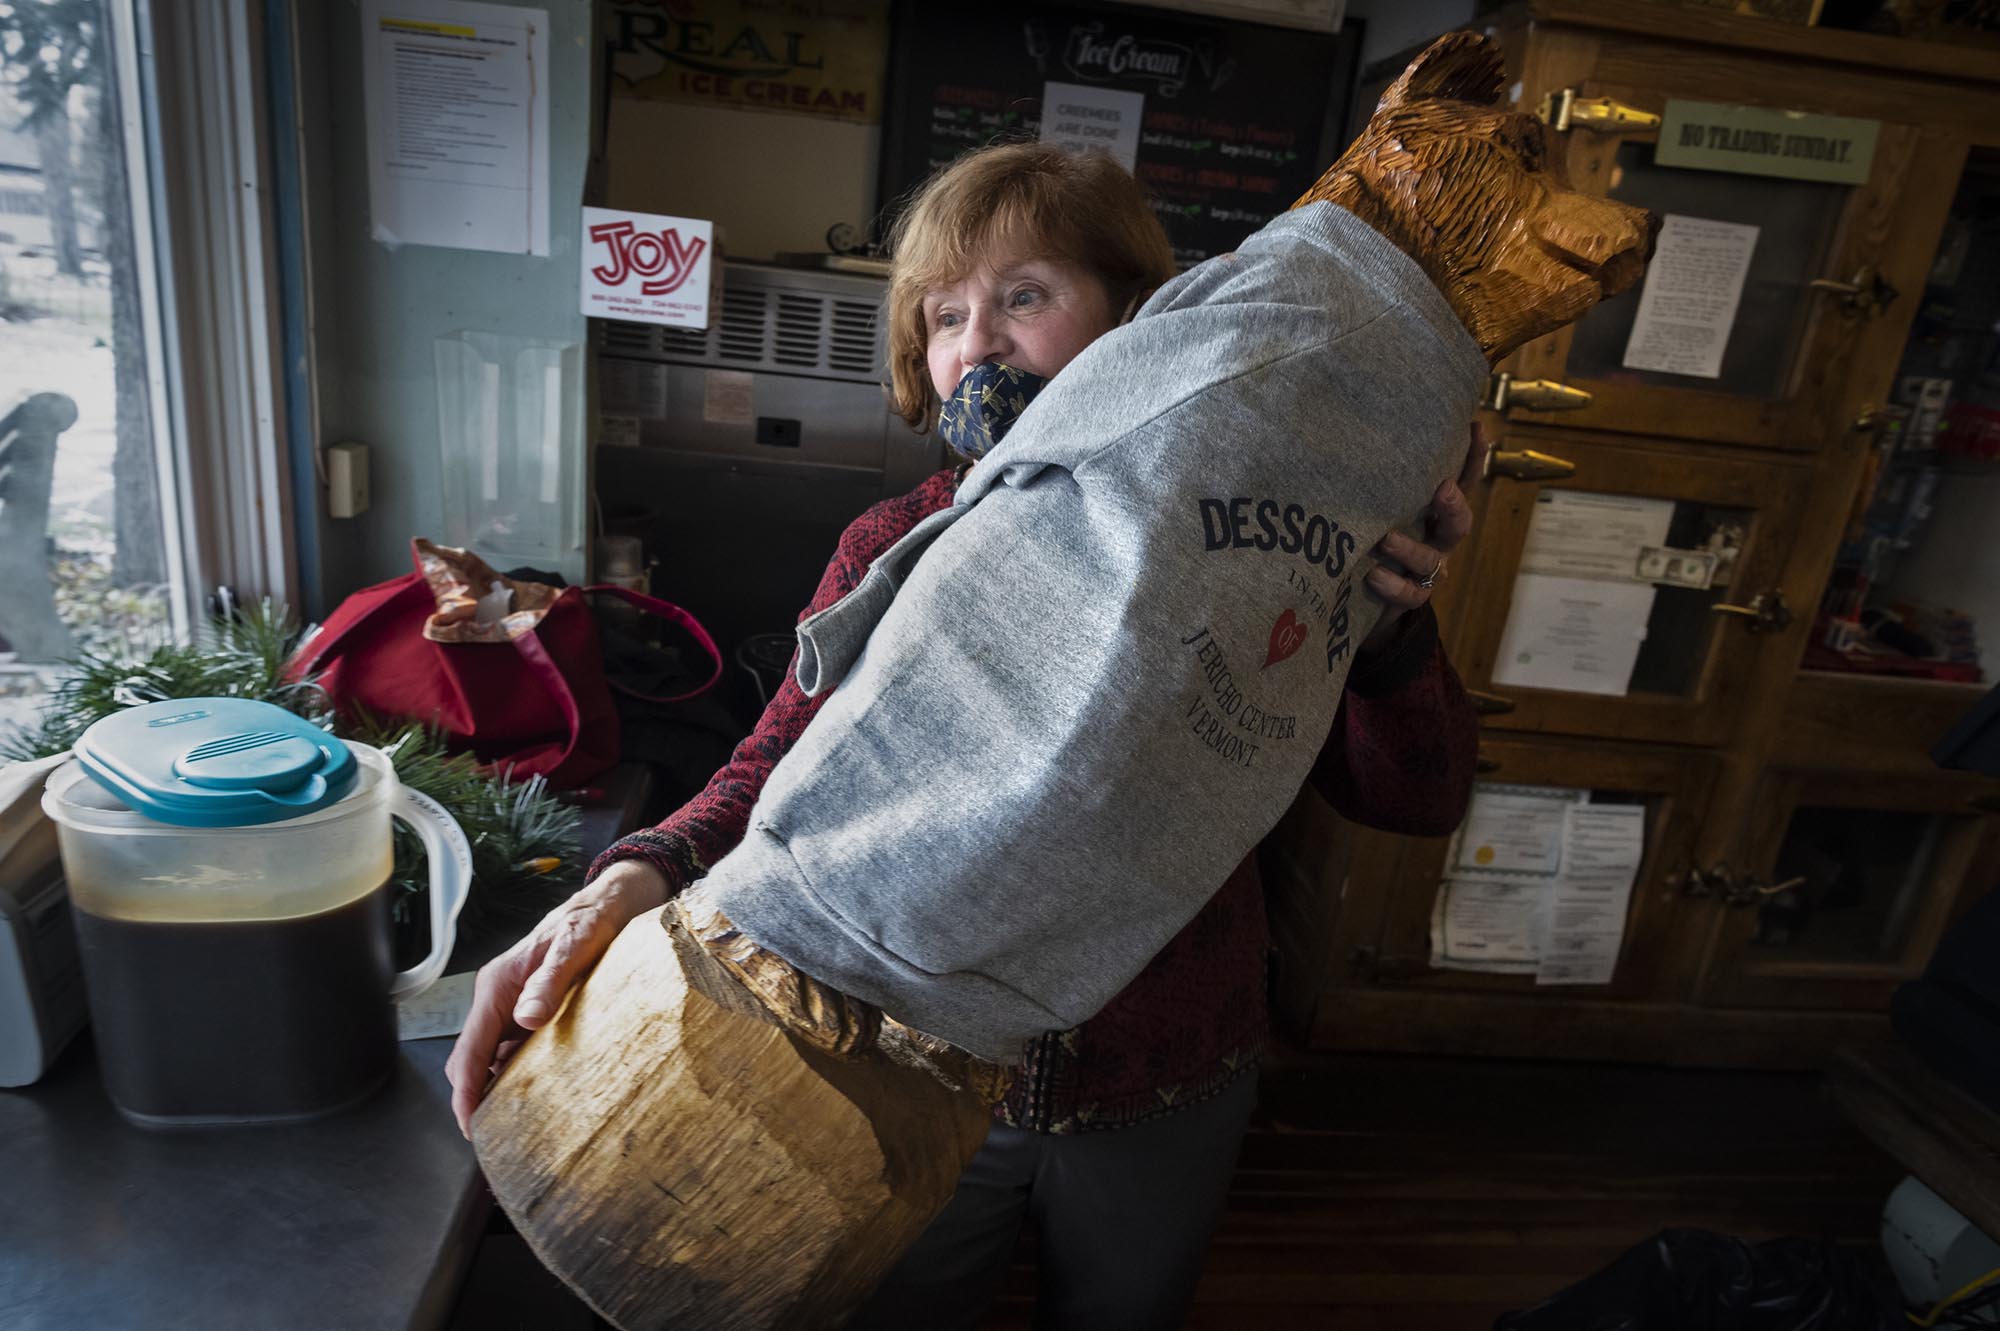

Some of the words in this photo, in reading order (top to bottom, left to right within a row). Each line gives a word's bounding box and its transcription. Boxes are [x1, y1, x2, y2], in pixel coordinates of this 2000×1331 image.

[614, 10, 824, 74] REAL
[680, 74, 731, 97] ICE
[743, 80, 865, 113] CREAM
[1055, 122, 1081, 135] ARE
[1083, 126, 1120, 141] DONE
[1679, 123, 1705, 147] NO
[1708, 126, 1782, 156] TRADING
[1199, 498, 1355, 578] DESSO'S
[1288, 568, 1311, 594] IN
[1278, 625, 1300, 655] OF
[1181, 627, 1242, 716] JERICHO
[1239, 703, 1297, 740] CENTER
[1187, 695, 1260, 768] VERMONT
